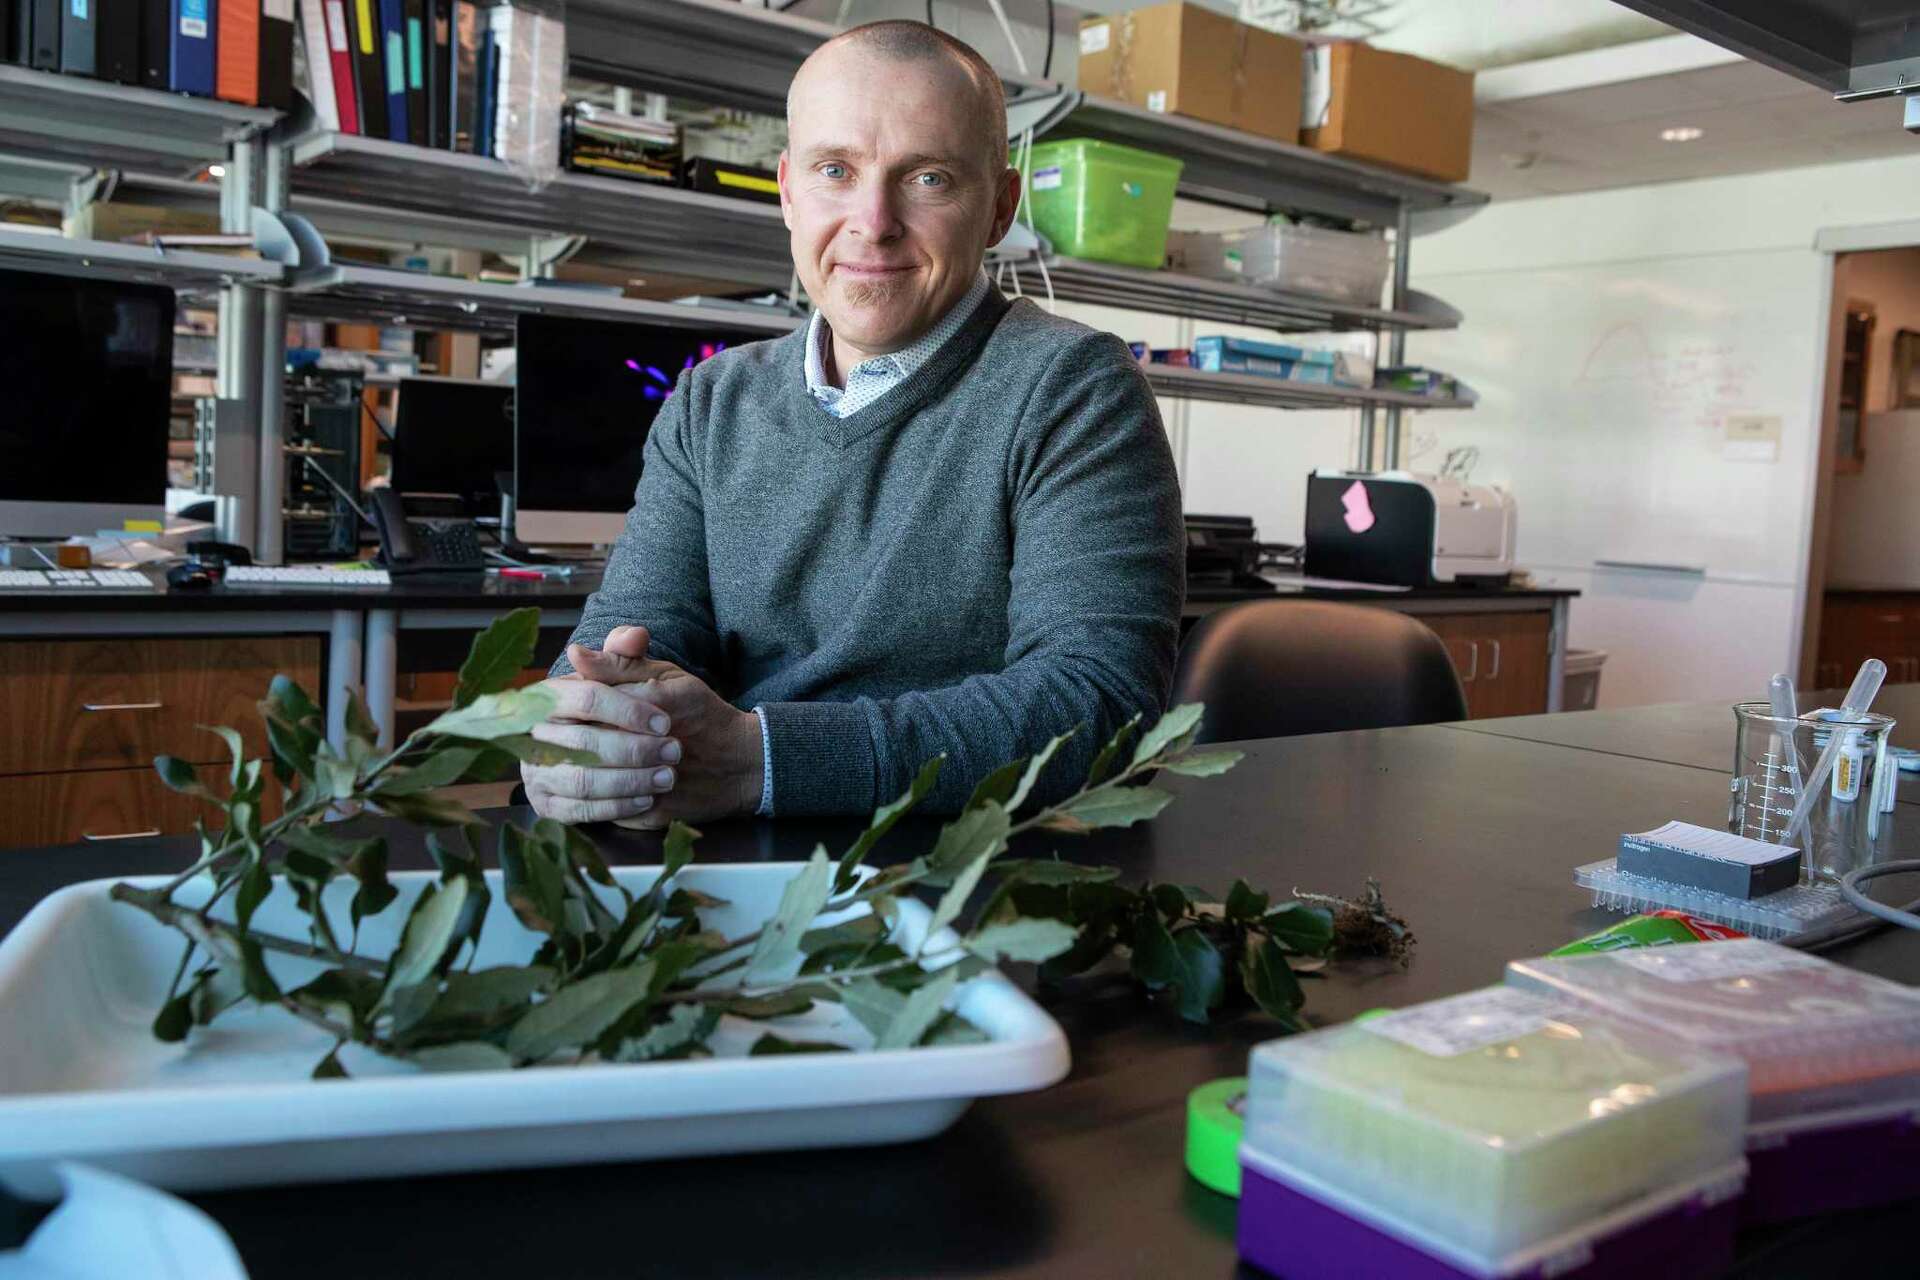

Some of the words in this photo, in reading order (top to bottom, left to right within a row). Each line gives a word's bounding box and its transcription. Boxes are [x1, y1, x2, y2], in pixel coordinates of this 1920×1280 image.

[1781, 765, 1798, 774] 300
[1779, 786, 1796, 796] 250
[1776, 807, 1793, 817] 200
[1775, 829, 1791, 838] 150
